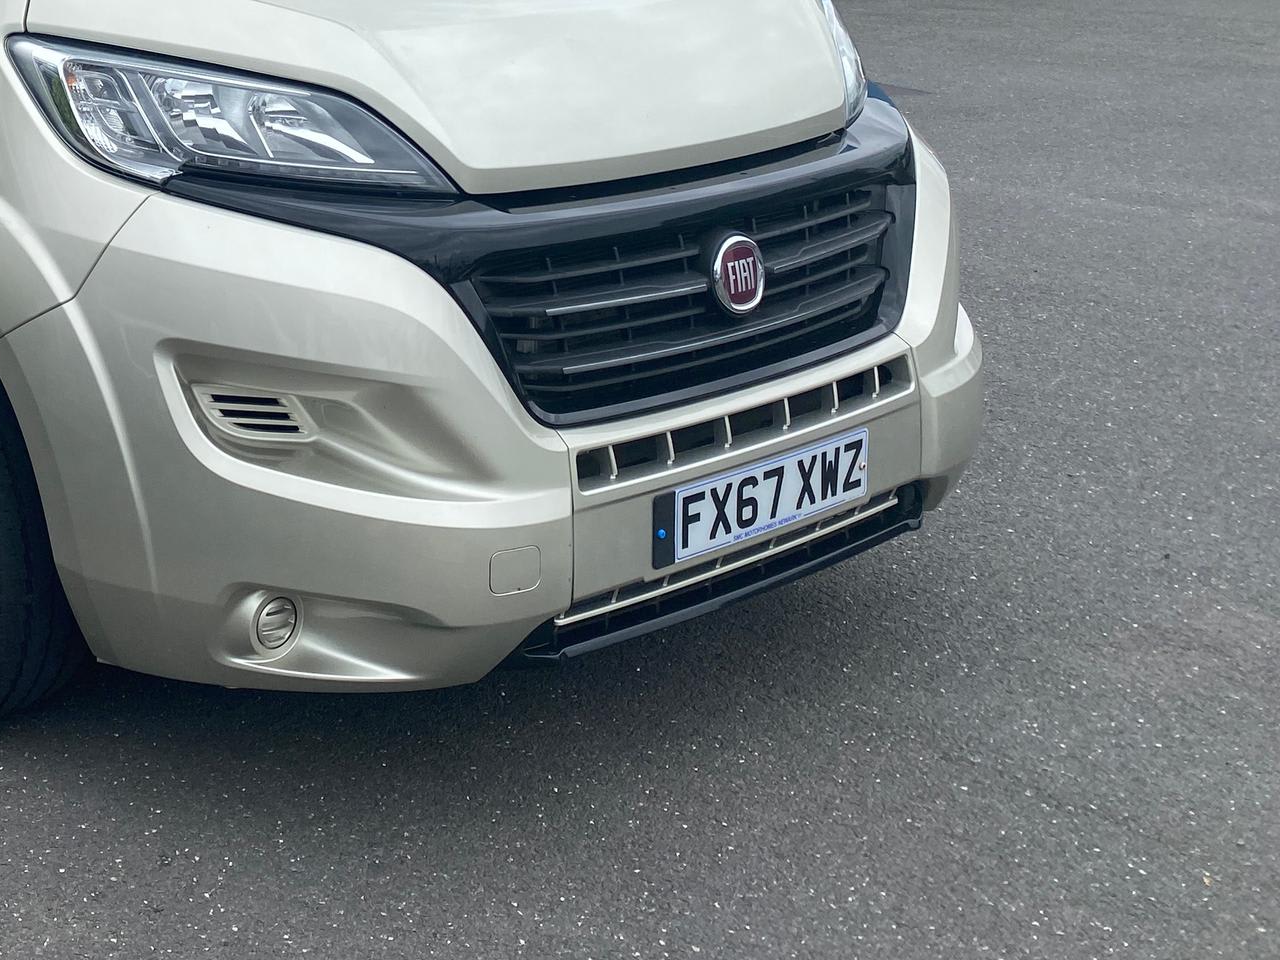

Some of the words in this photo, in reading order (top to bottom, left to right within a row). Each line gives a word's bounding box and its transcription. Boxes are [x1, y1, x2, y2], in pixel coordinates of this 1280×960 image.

[726, 256, 755, 294] FIAT
[681, 465, 785, 550] FX67
[795, 438, 863, 511] XWZ
